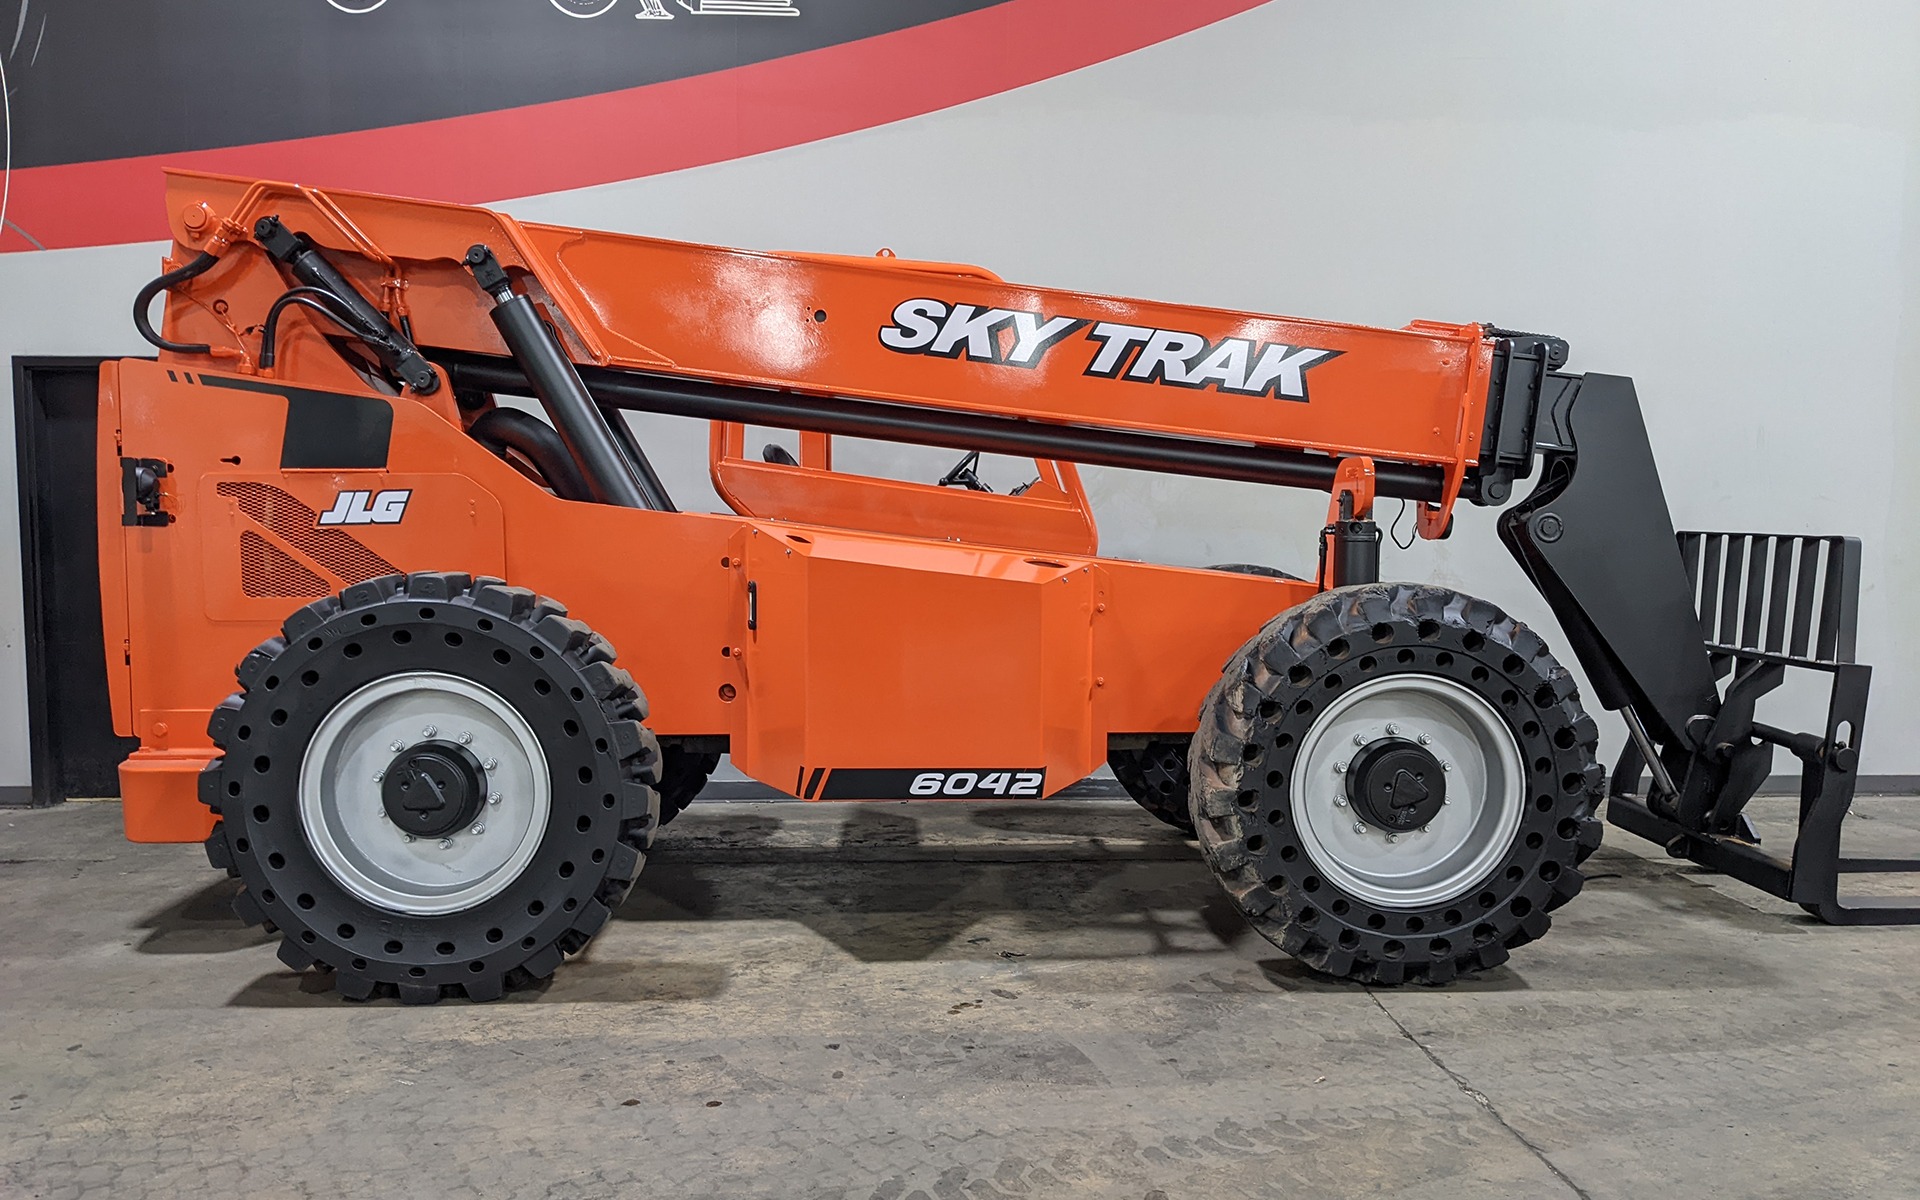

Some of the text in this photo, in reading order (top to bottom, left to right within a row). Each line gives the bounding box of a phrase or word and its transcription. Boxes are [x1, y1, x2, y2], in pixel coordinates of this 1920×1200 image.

[880, 298, 1340, 401] SKY TRAK
[318, 490, 411, 524] JLG
[909, 772, 1043, 796] 6042
